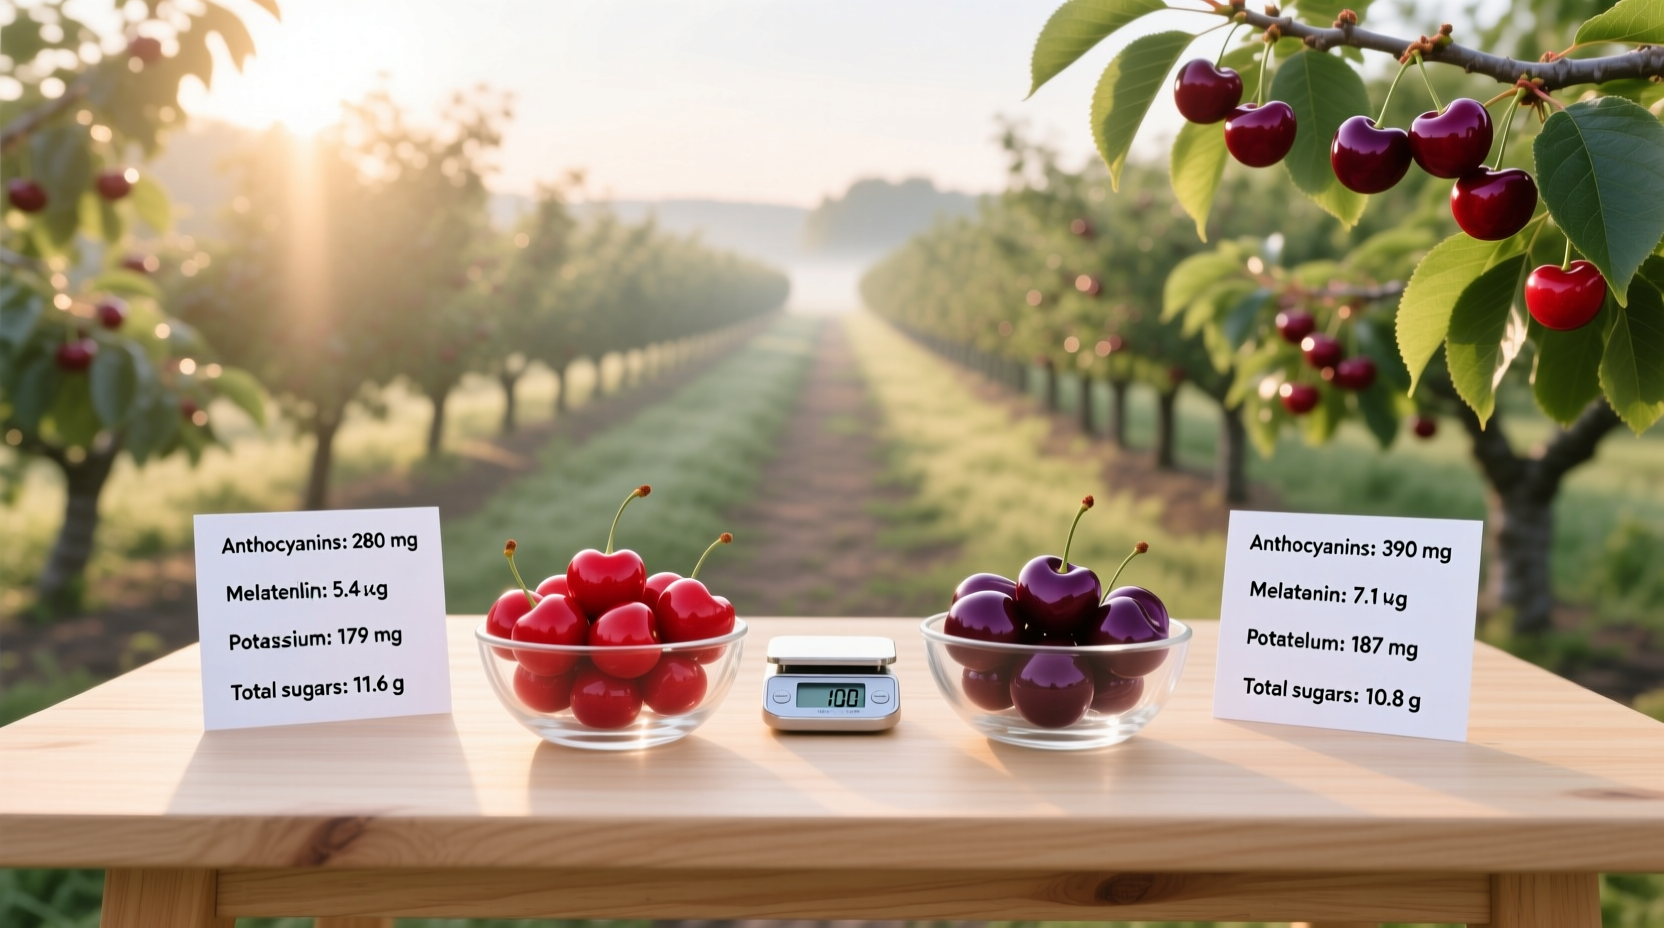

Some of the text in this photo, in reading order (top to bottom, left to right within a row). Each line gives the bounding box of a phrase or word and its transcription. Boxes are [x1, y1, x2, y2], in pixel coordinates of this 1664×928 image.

[221, 532, 418, 557] Anthocyanins: 280 mg
[1249, 533, 1452, 565] Anthocyanins: 390 mg
[1353, 586, 1378, 605] 7.1
[229, 626, 403, 651] Potassium: 179 mg
[1351, 635, 1384, 655] 187
[1388, 642, 1419, 662] mg
[230, 674, 405, 702] Total sugars: 11.6 g
[828, 688, 859, 708] 100
[1243, 677, 1421, 714] Total sugars: 10.8 g
